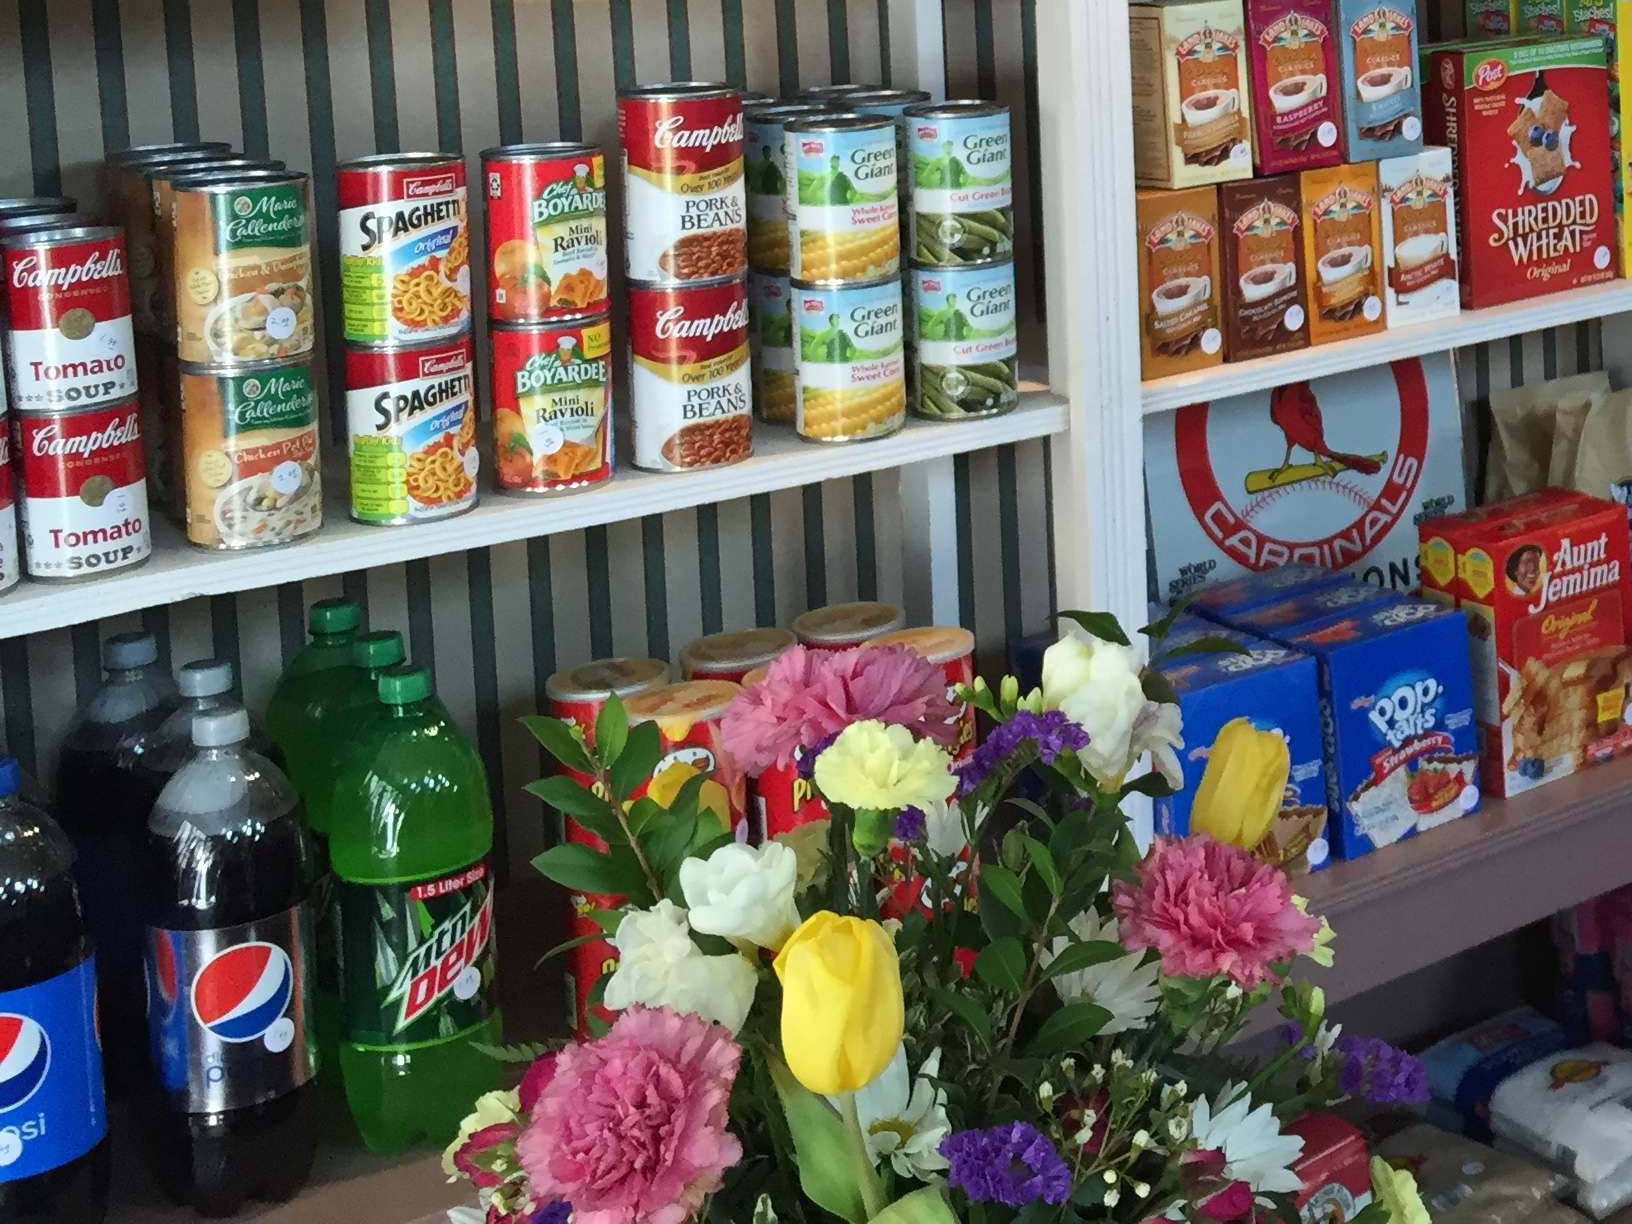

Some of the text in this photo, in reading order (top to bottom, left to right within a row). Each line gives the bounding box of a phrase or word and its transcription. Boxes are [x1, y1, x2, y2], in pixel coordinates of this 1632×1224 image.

[1478, 64, 1504, 87] Post
[654, 112, 744, 152] Campbell
[963, 133, 1007, 151] Green
[850, 147, 894, 165] Green
[965, 147, 1008, 165] Giant
[854, 162, 894, 181] Giant
[542, 183, 571, 200] Chef
[680, 182, 706, 194] Over
[685, 196, 729, 214] PORK
[568, 223, 593, 237] Mini
[680, 208, 742, 231] BEANS
[1489, 195, 1599, 247] SHREDDED
[1508, 226, 1596, 266] WHEAT
[12, 249, 123, 291] Campbell's
[1526, 261, 1571, 280] Original
[966, 283, 1012, 302] Green
[656, 299, 749, 341] Campbell
[849, 303, 898, 323] Green
[970, 300, 1011, 319] Giant
[854, 318, 897, 339] Giant
[30, 352, 126, 383] Tomato
[525, 353, 554, 371] Chef
[516, 360, 606, 393] BOYARDEE
[682, 371, 706, 384] Over
[46, 381, 117, 404] SOUP
[551, 394, 580, 409] Mini
[687, 385, 732, 403] PORK
[535, 400, 596, 424] Ravioli
[682, 396, 746, 421] BEANS
[31, 413, 141, 458] Campbell's
[1204, 453, 1418, 569] CARDINALS
[49, 518, 143, 549] Tomato
[67, 544, 135, 570] SOUP
[1553, 532, 1609, 573] Aunt
[1178, 559, 1217, 577] WORLD
[1528, 559, 1620, 614] Jemima
[1541, 599, 1598, 639] Original
[1382, 735, 1444, 774] Strawberry
